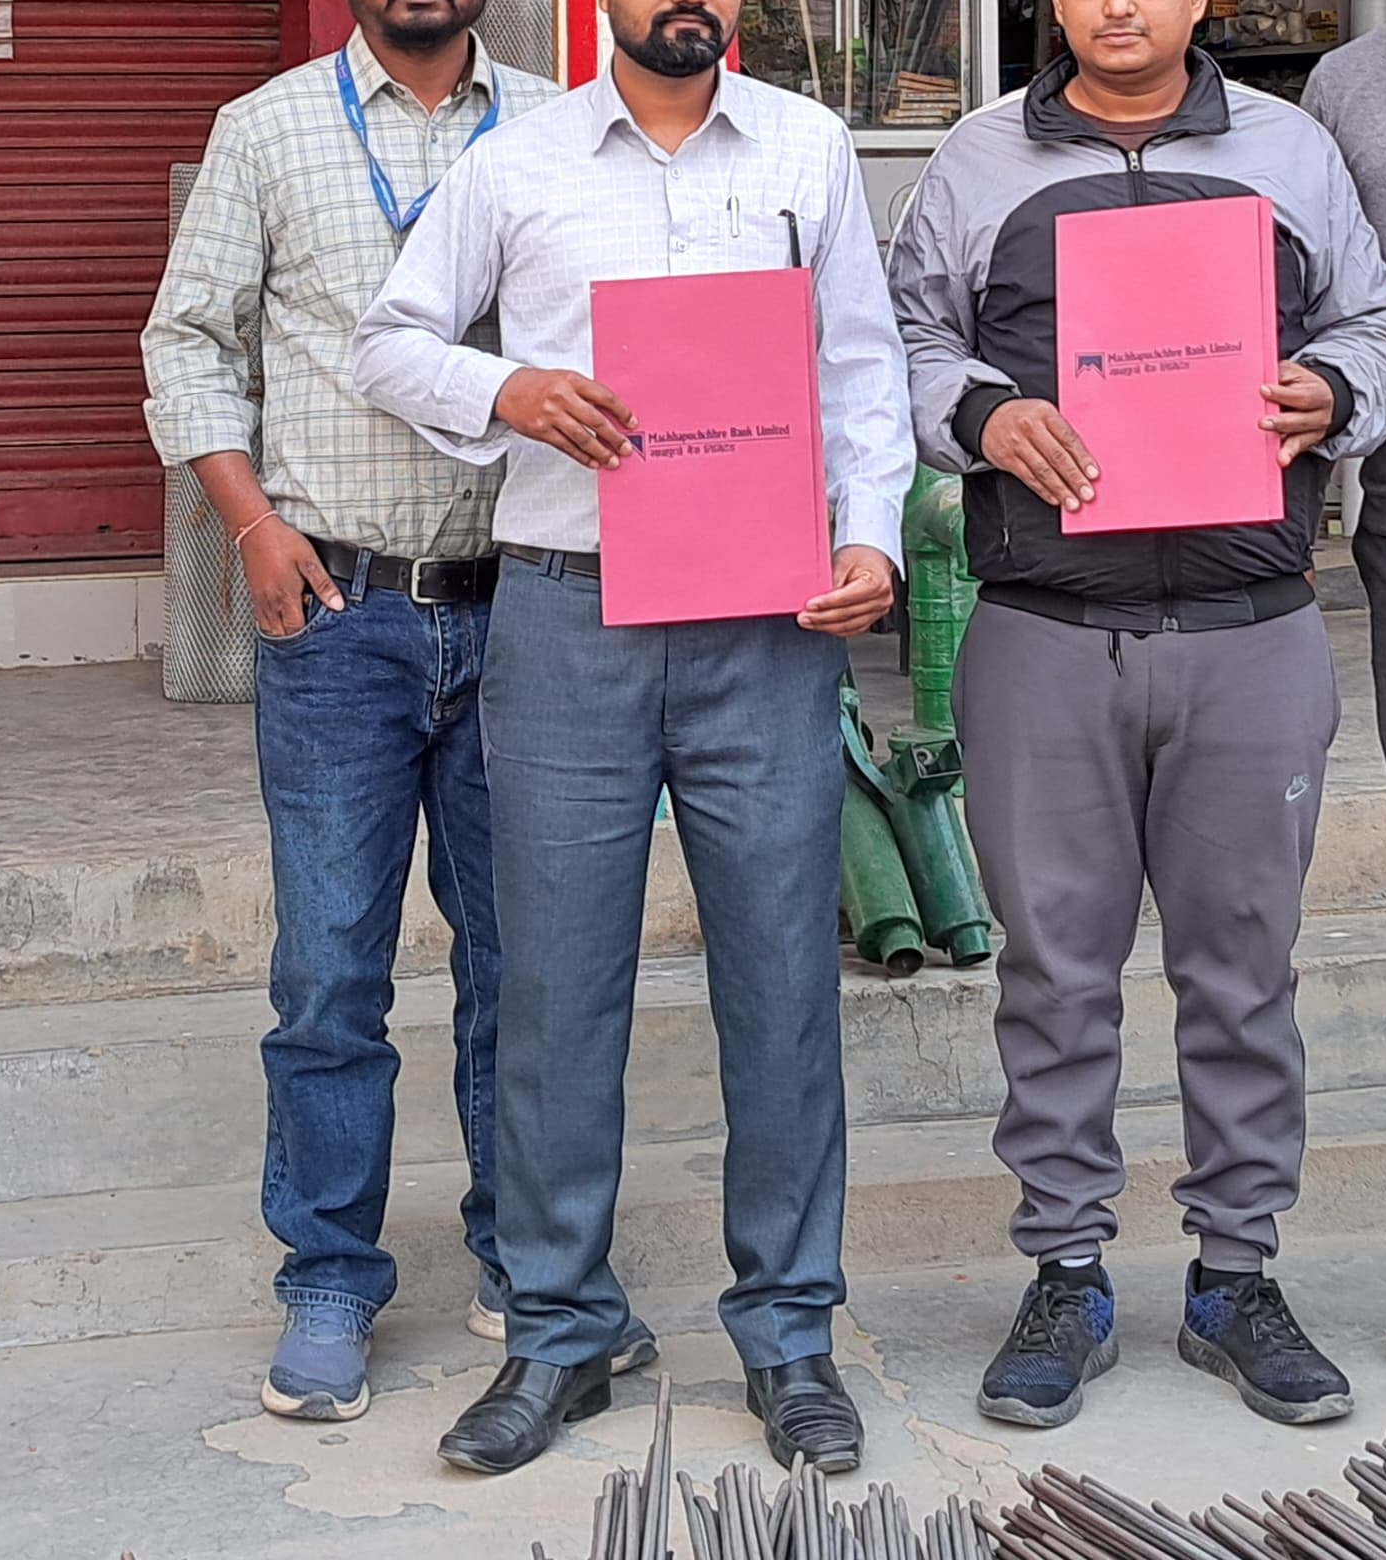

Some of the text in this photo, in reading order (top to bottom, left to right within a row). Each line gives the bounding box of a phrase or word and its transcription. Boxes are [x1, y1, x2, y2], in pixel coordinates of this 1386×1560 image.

[1185, 344, 1207, 356] Bank
[1209, 341, 1242, 354] Limited
[730, 426, 753, 438] Bank
[756, 424, 790, 436] Limited
